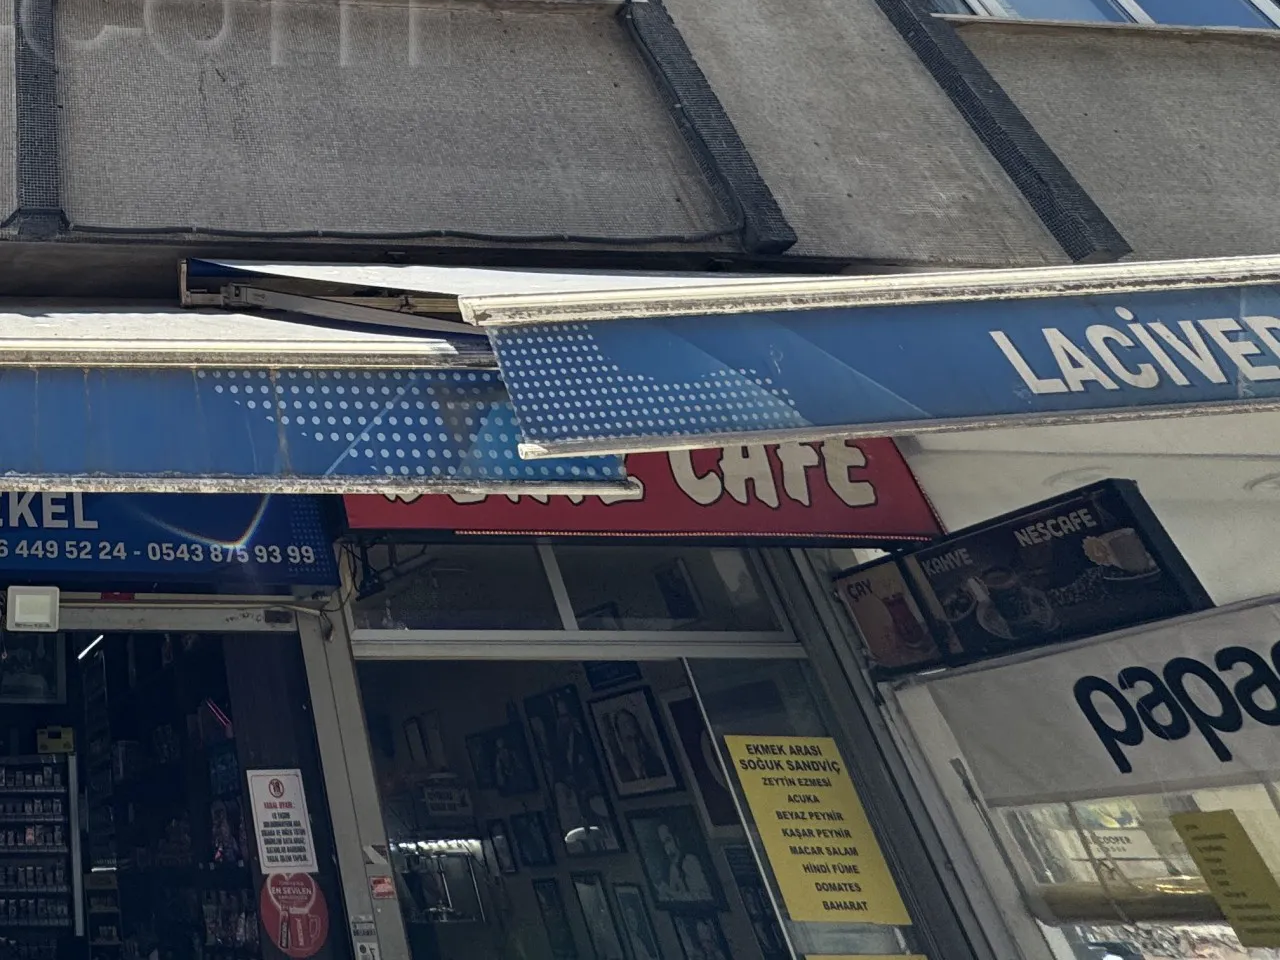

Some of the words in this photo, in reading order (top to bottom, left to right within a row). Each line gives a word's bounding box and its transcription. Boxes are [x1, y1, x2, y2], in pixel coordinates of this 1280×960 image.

[1013, 508, 1097, 548] NESCAFE
[15, 540, 59, 559] 449
[65, 541, 93, 560] 52
[99, 542, 127, 560] 24
[147, 542, 203, 562] 0543
[210, 543, 248, 563] 875
[256, 545, 282, 563] 93
[288, 545, 315, 564] 99
[920, 547, 973, 577] KAHVE
[846, 578, 874, 603] ÇAY
[1073, 637, 1280, 773] papa
[745, 743, 787, 756] EKMEK
[788, 744, 822, 756] ARASI
[739, 756, 784, 771] SOĞUK
[786, 759, 841, 775] SANDVİÇ
[761, 776, 796, 787] ZEYTİN
[799, 777, 832, 787] EZMESİ
[787, 794, 820, 804] ACUKA
[775, 810, 806, 820] BEYAZ
[809, 811, 844, 821] PEYNİR
[781, 828, 814, 839] KAŞAR
[817, 828, 852, 839] PEYNİR
[789, 845, 824, 856] MACAR
[827, 846, 859, 857] SALAM
[802, 863, 830, 874] HİNDİ
[833, 863, 860, 874] FÜME
[815, 882, 862, 892] DOMATES
[822, 900, 868, 911] BAHARAT
